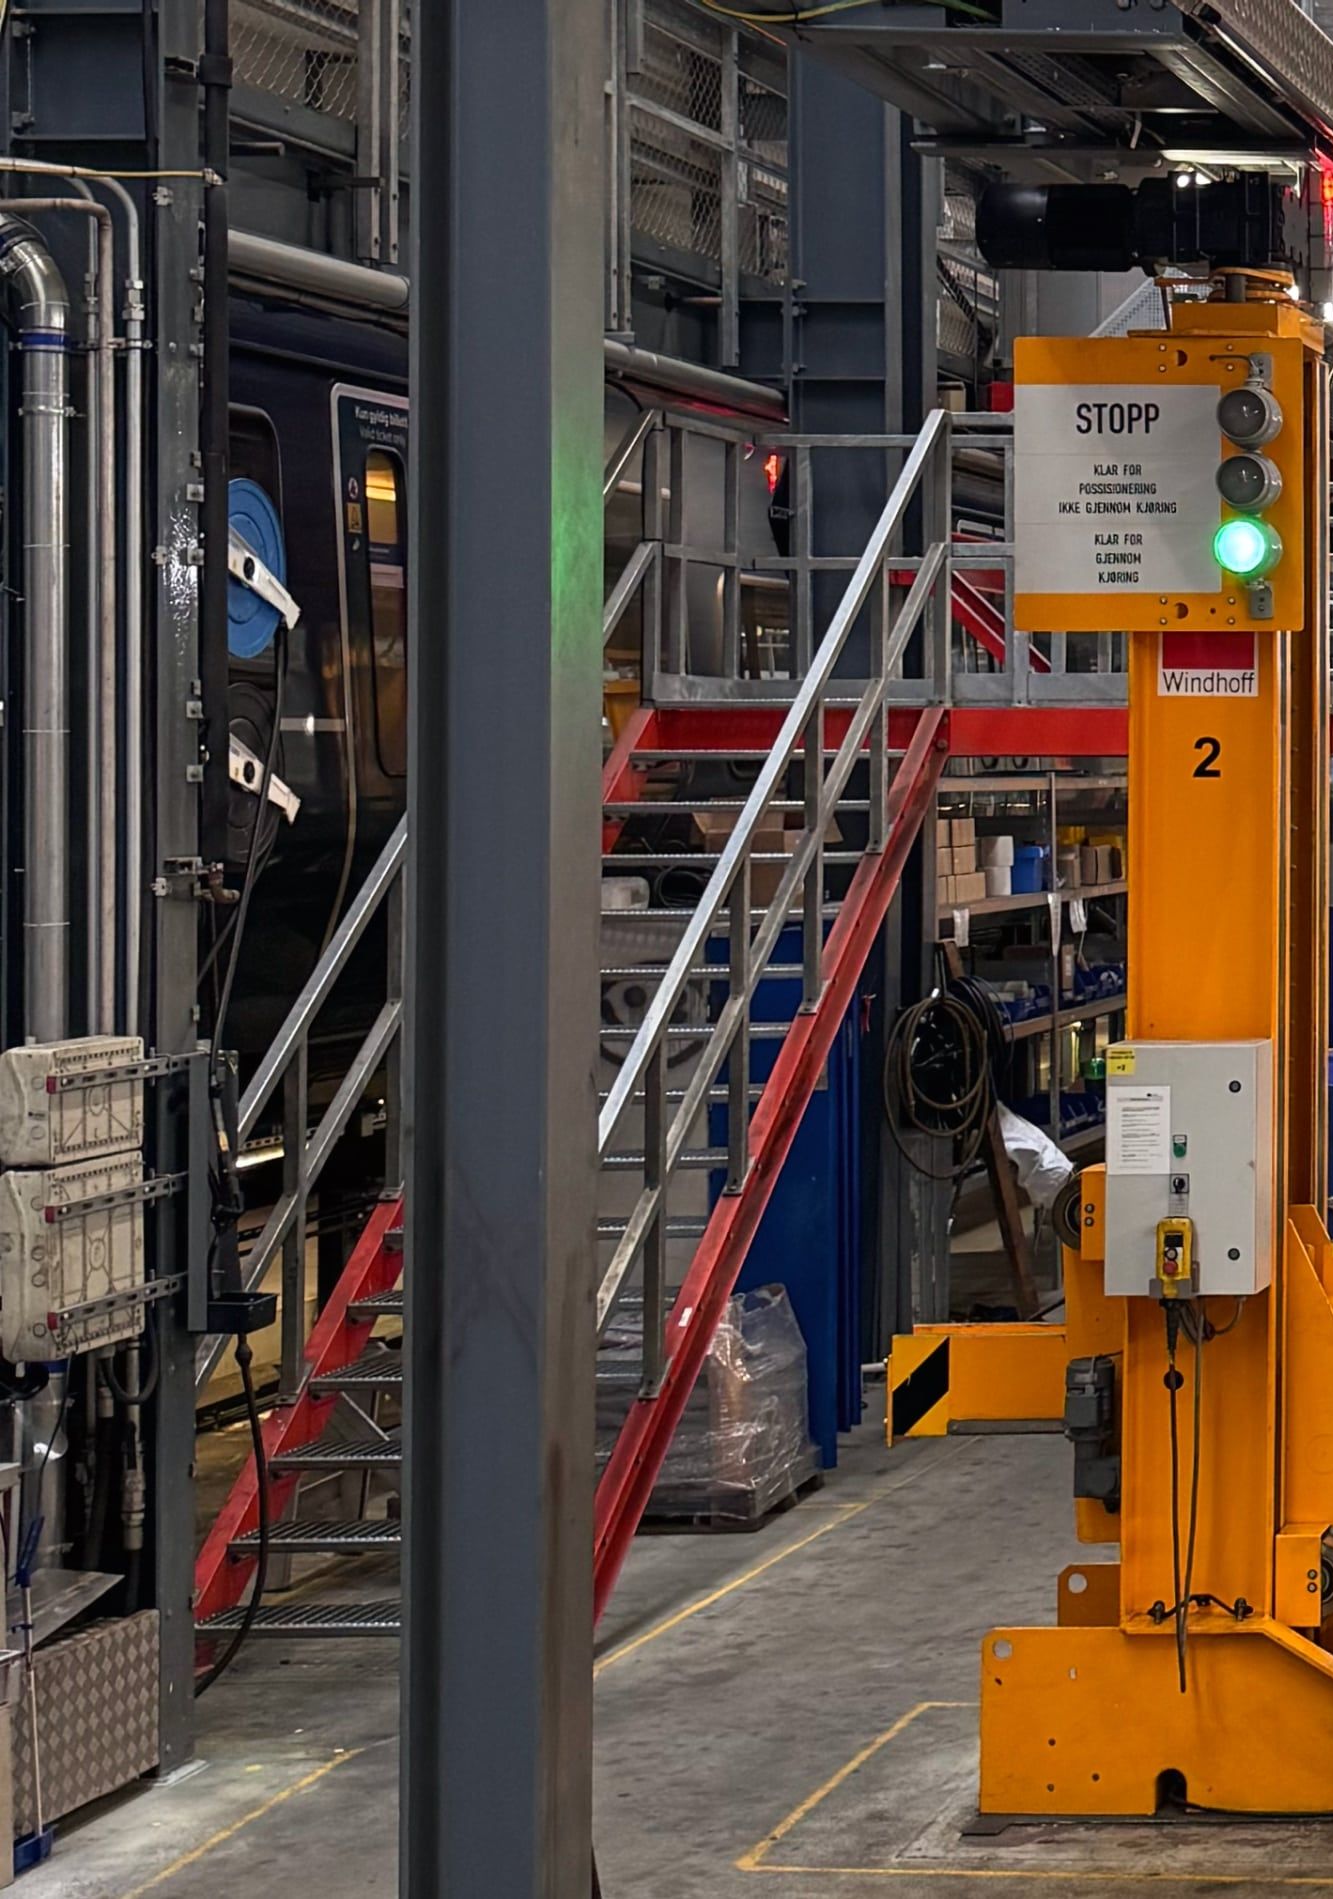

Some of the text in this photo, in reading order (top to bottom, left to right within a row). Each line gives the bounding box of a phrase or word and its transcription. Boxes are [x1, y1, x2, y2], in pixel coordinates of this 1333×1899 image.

[1076, 403, 1160, 434] STOPP
[1093, 464, 1142, 476] KLAR FOR
[1079, 483, 1157, 495] POSSISIONERING
[1058, 502, 1177, 514] IKKE GJENNOM KJØRING
[1094, 534, 1143, 545] KLAR FOR
[1096, 553, 1141, 564] GJENNOM
[1098, 572, 1139, 583] KJØRING
[1162, 671, 1256, 693] Windhoff
[1192, 736, 1221, 778] 2
